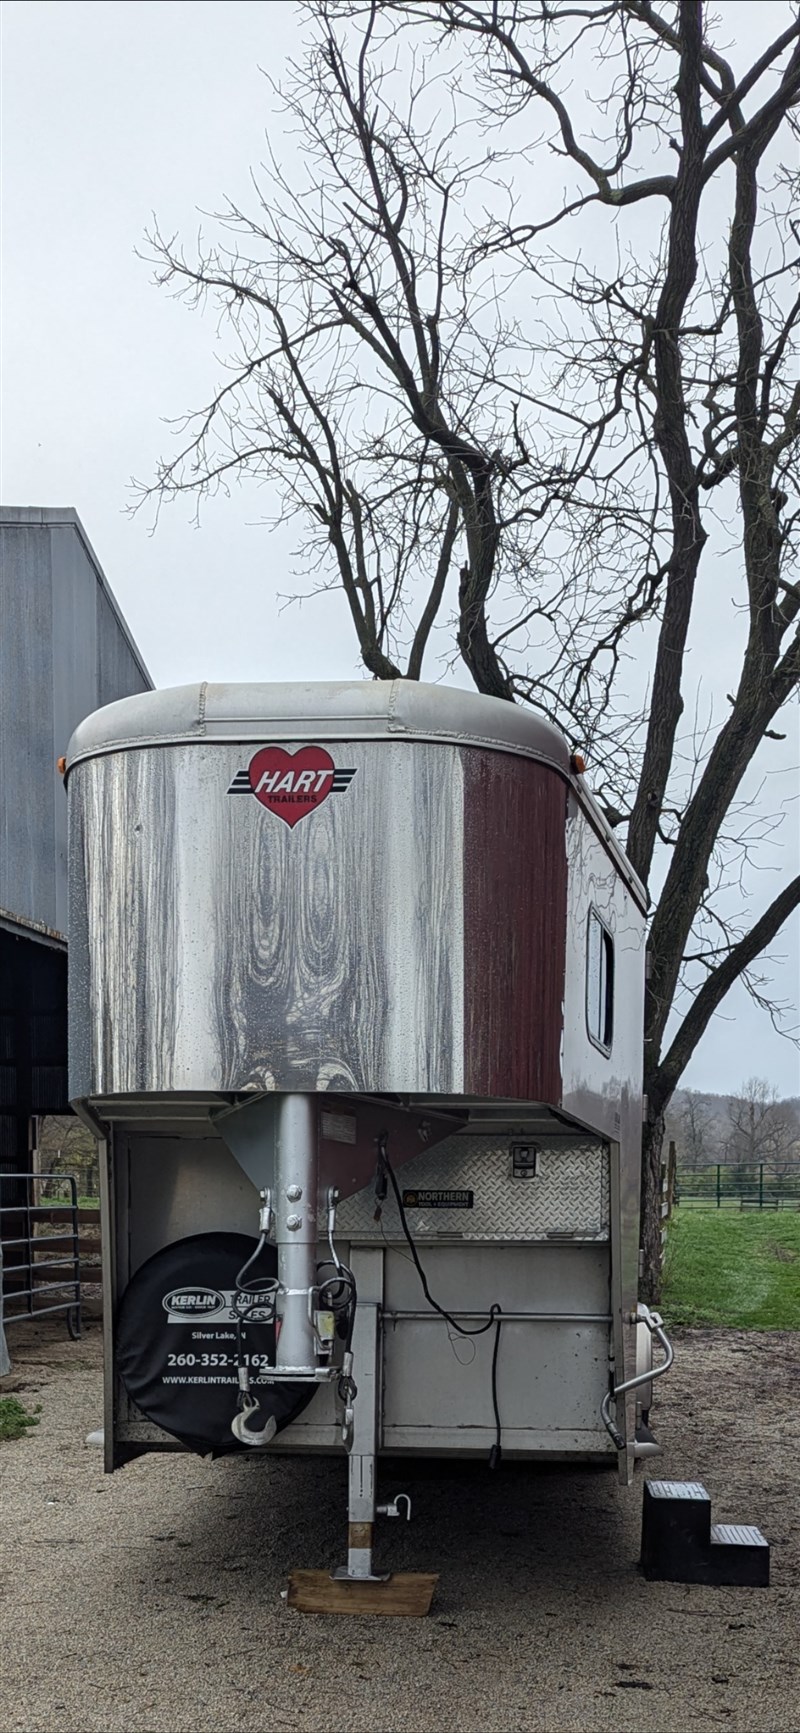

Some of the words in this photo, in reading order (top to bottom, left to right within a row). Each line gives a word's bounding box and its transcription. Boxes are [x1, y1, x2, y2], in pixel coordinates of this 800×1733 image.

[254, 769, 335, 793] HART
[267, 794, 317, 804] TRAILERS
[418, 1191, 469, 1201] NORTHERN
[171, 1295, 217, 1306] KERLIN
[191, 1331, 214, 1340] Silver
[215, 1331, 237, 1341] Lake,
